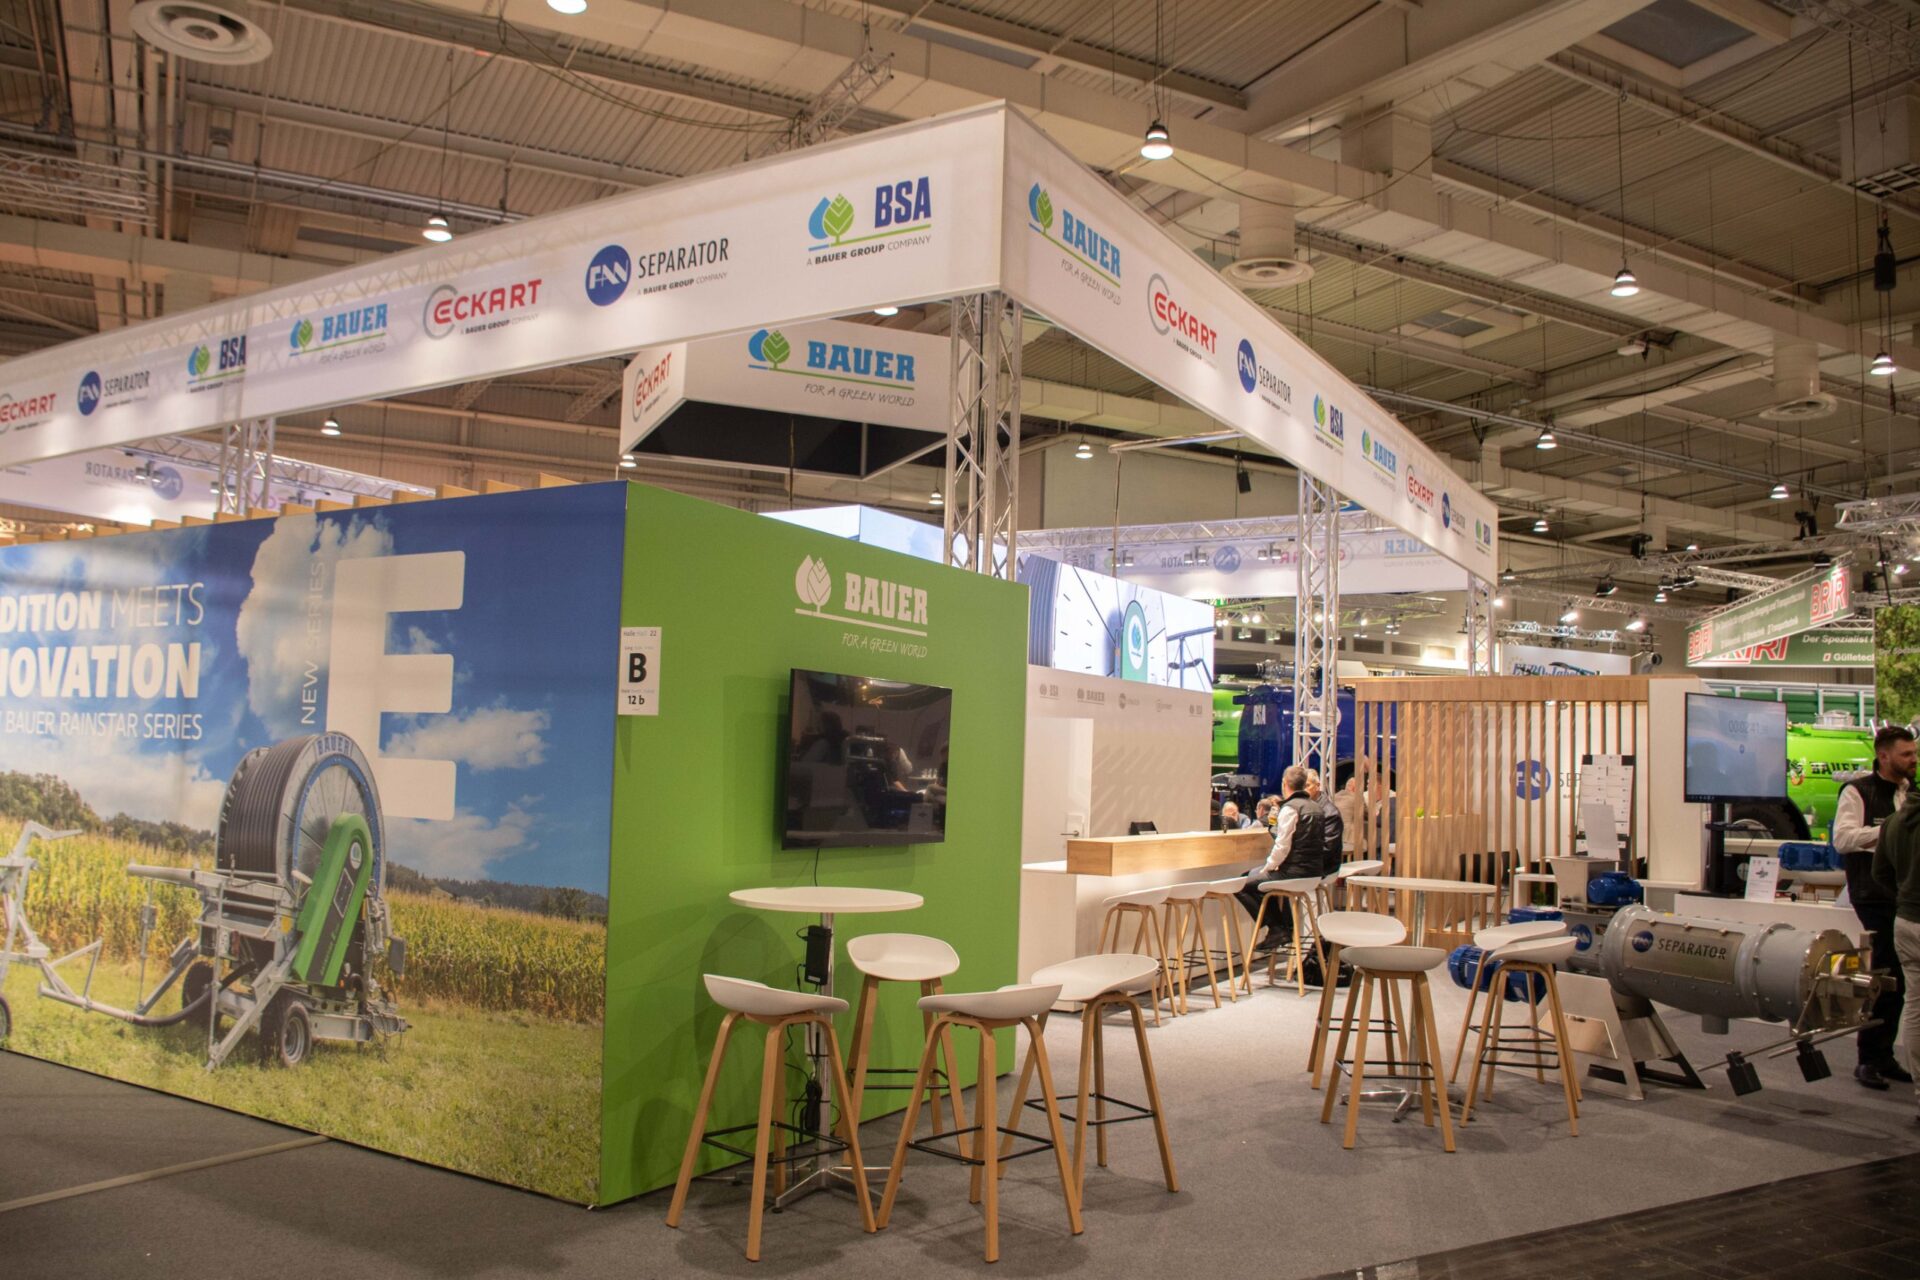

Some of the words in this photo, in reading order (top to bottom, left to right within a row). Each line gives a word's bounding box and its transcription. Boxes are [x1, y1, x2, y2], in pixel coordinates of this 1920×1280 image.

[874, 176, 931, 229] BSA
[638, 238, 729, 279] SEPARATOR
[814, 250, 848, 265] BAUER
[849, 243, 885, 258] GROUP
[887, 234, 932, 251] COMPANY
[1062, 208, 1121, 279] BAUER
[642, 283, 668, 296] BAUER
[669, 278, 694, 291] GROUP
[696, 272, 728, 286] COMPANY
[1060, 258, 1073, 273] FOR
[1080, 271, 1100, 293] GREEN
[1101, 285, 1121, 306] WORLD
[433, 279, 542, 325] ECKART
[321, 303, 388, 342] BAUER
[465, 322, 487, 335] BAUER
[487, 318, 510, 331] GROUP
[1154, 291, 1217, 355] ECKART
[219, 335, 247, 371] BSA
[807, 340, 915, 382] BAUER
[104, 371, 150, 397] SEPARATOR
[634, 351, 672, 406] ECKART
[804, 383, 826, 395] FOR
[827, 386, 836, 396] A
[838, 387, 876, 402] GREEN
[878, 393, 915, 407] WORLD
[1258, 365, 1292, 405] SEPARATOR
[0, 393, 56, 424] ECKART
[1329, 404, 1344, 442] BSA
[1373, 441, 1397, 475] BAUER
[1408, 476, 1434, 508] ECKART
[111, 582, 205, 629] MEETS
[305, 560, 327, 651] SERIES
[844, 572, 928, 625] BAUER
[842, 632, 860, 649] FOR
[860, 637, 868, 649] A
[869, 637, 899, 654] GREEN
[900, 643, 928, 659] WORLD
[1802, 635, 1820, 644] Der
[1821, 635, 1869, 645] Spezialist
[326, 550, 466, 822] E
[628, 652, 647, 683] B
[300, 659, 319, 725] NEW
[628, 695, 637, 705] 12
[638, 694, 645, 705] b
[6, 711, 56, 735] BAUER
[60, 712, 139, 738] RAINSTAR
[142, 713, 203, 740] SERIES
[316, 735, 350, 756] BAUER
[1658, 938, 1727, 960] SEPARATOR
